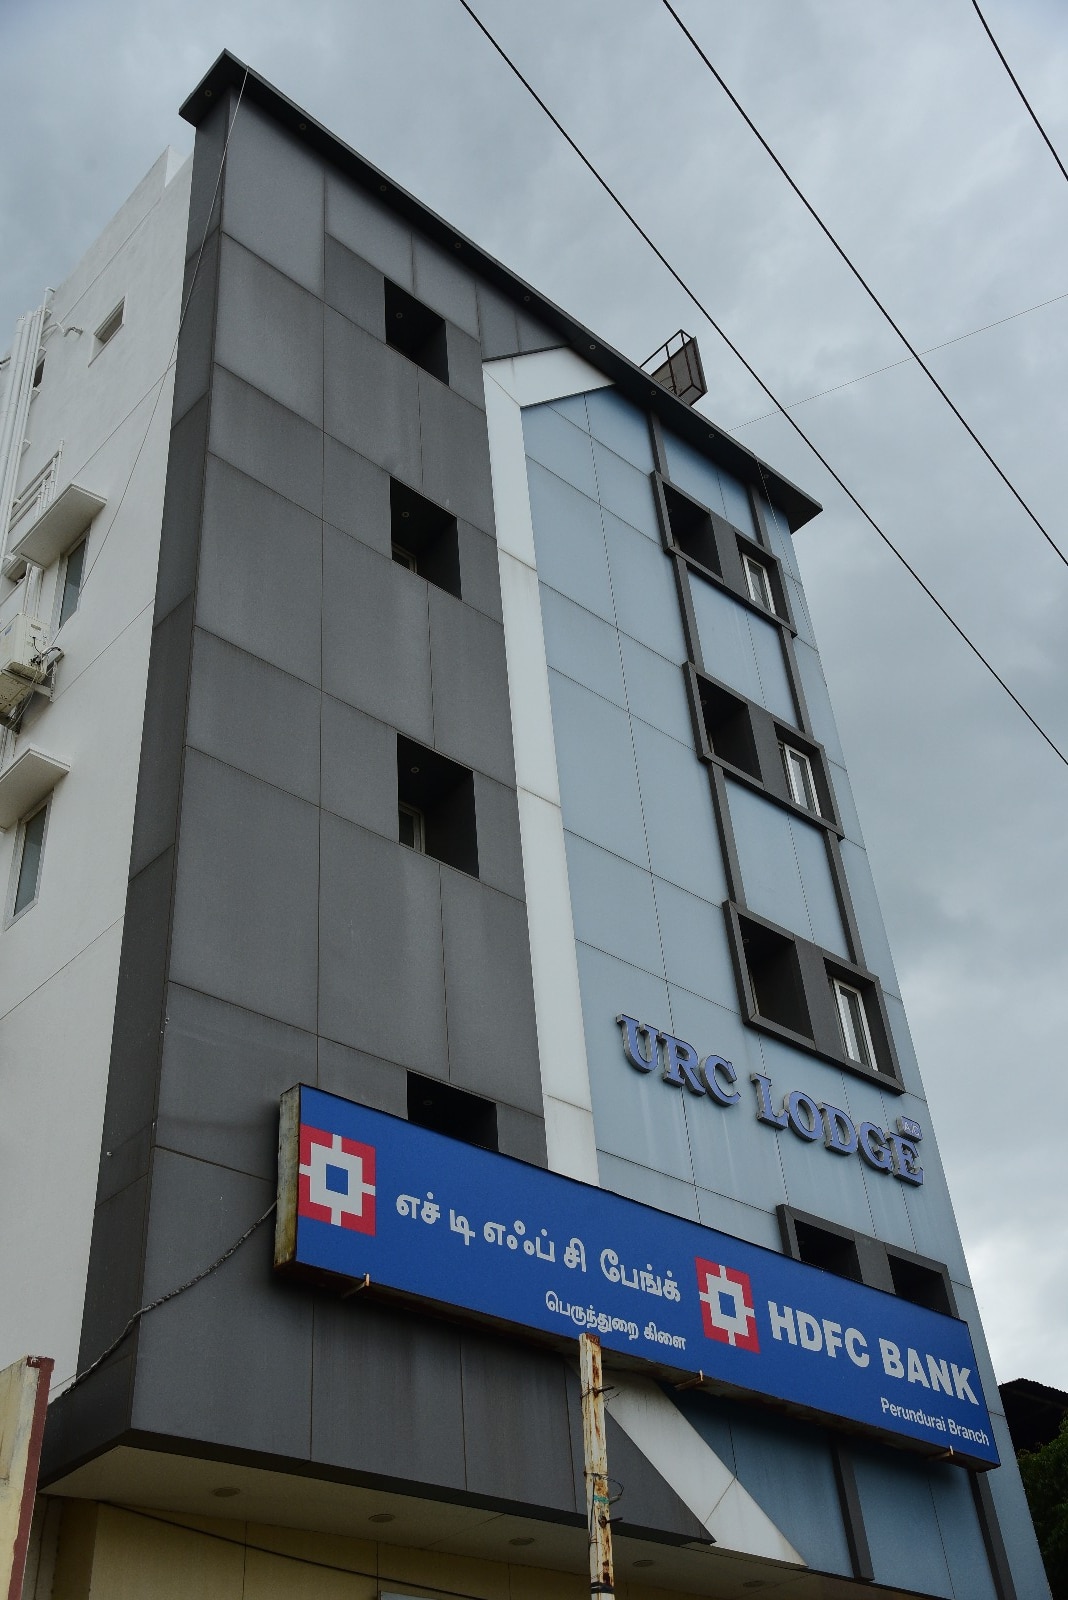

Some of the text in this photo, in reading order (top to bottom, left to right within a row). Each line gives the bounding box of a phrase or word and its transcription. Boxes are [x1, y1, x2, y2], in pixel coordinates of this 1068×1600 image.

[616, 1013, 924, 1187] URC LODGE
[396, 1191, 441, 1225] எச்
[449, 1209, 475, 1246] டி
[563, 1237, 587, 1273] சி
[600, 1249, 681, 1303] பேங்க்
[545, 1290, 687, 1351] பெருந்துறை கிளை
[767, 1300, 980, 1406] HDFC BANK
[880, 1397, 990, 1447] Perundurai Branch
